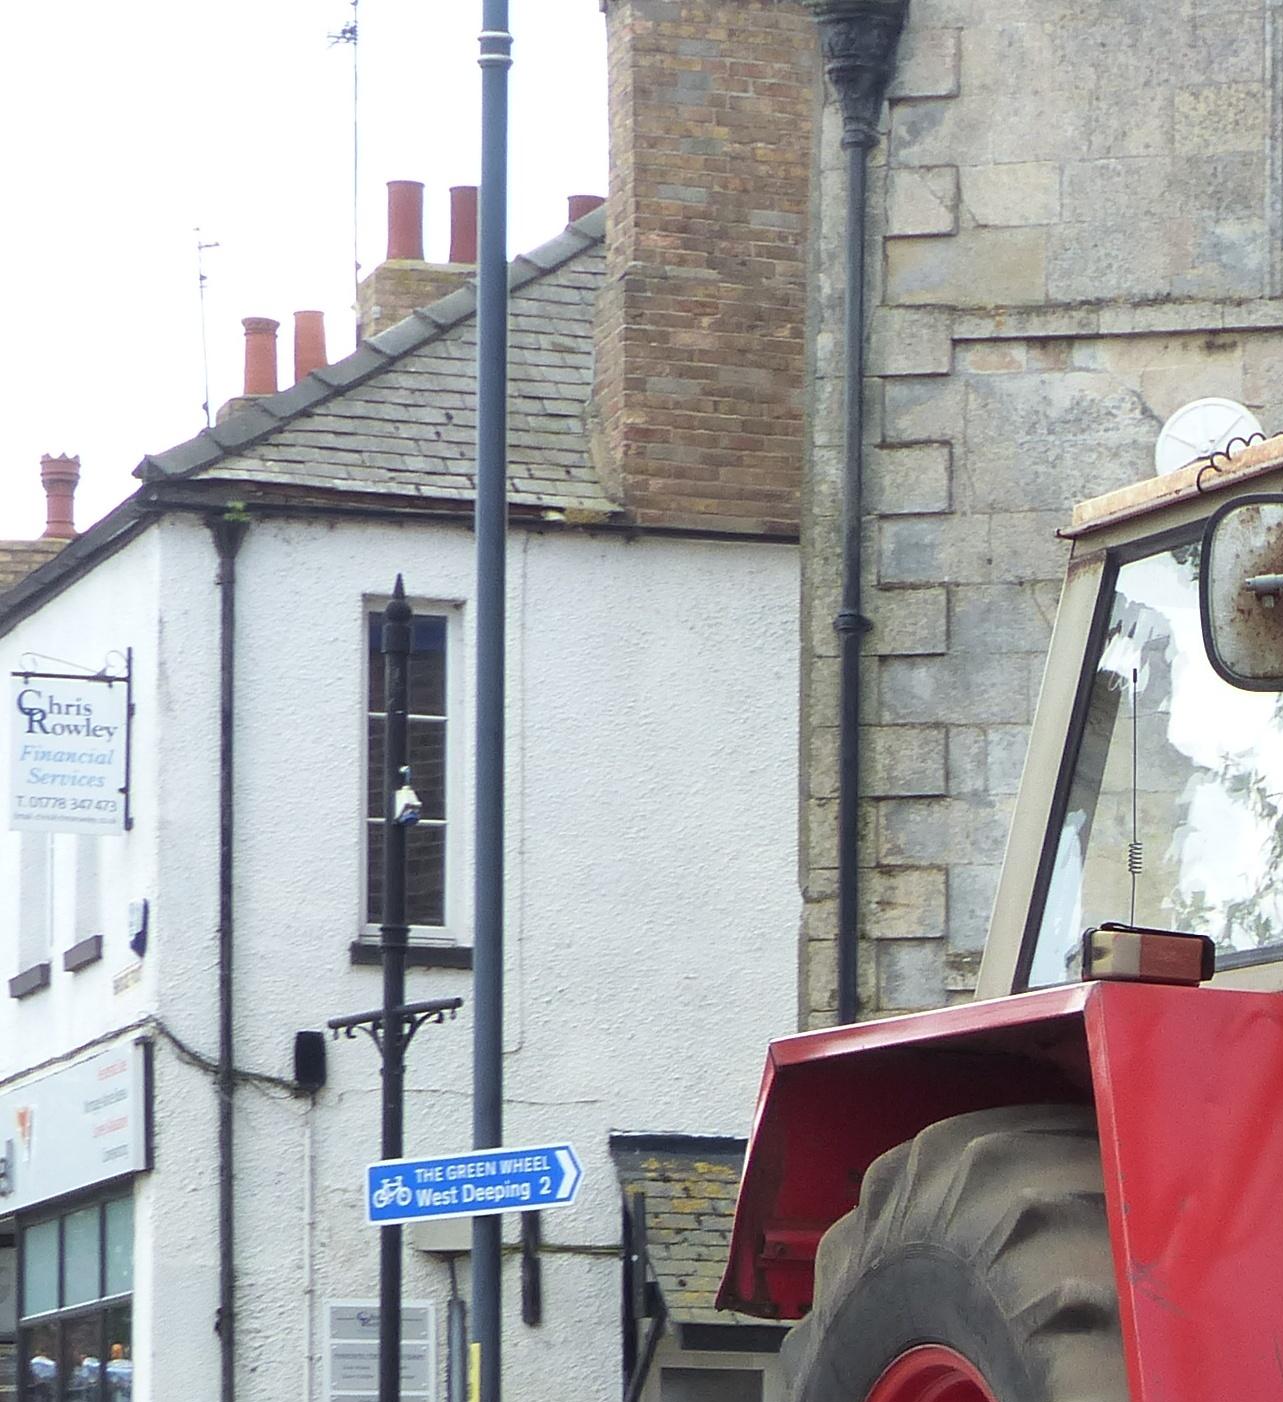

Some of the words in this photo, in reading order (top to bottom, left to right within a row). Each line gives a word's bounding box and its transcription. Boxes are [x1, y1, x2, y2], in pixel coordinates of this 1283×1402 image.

[17, 689, 92, 716] Chris
[26, 708, 117, 742] Rowley
[20, 745, 114, 765] Financial
[26, 767, 105, 788] Services
[414, 1166, 443, 1184] THE
[446, 1161, 497, 1182] GREEN
[499, 1154, 551, 1175] WHEEL
[415, 1187, 459, 1208] West
[462, 1178, 531, 1205] Deeping
[539, 1175, 552, 1196] 2
